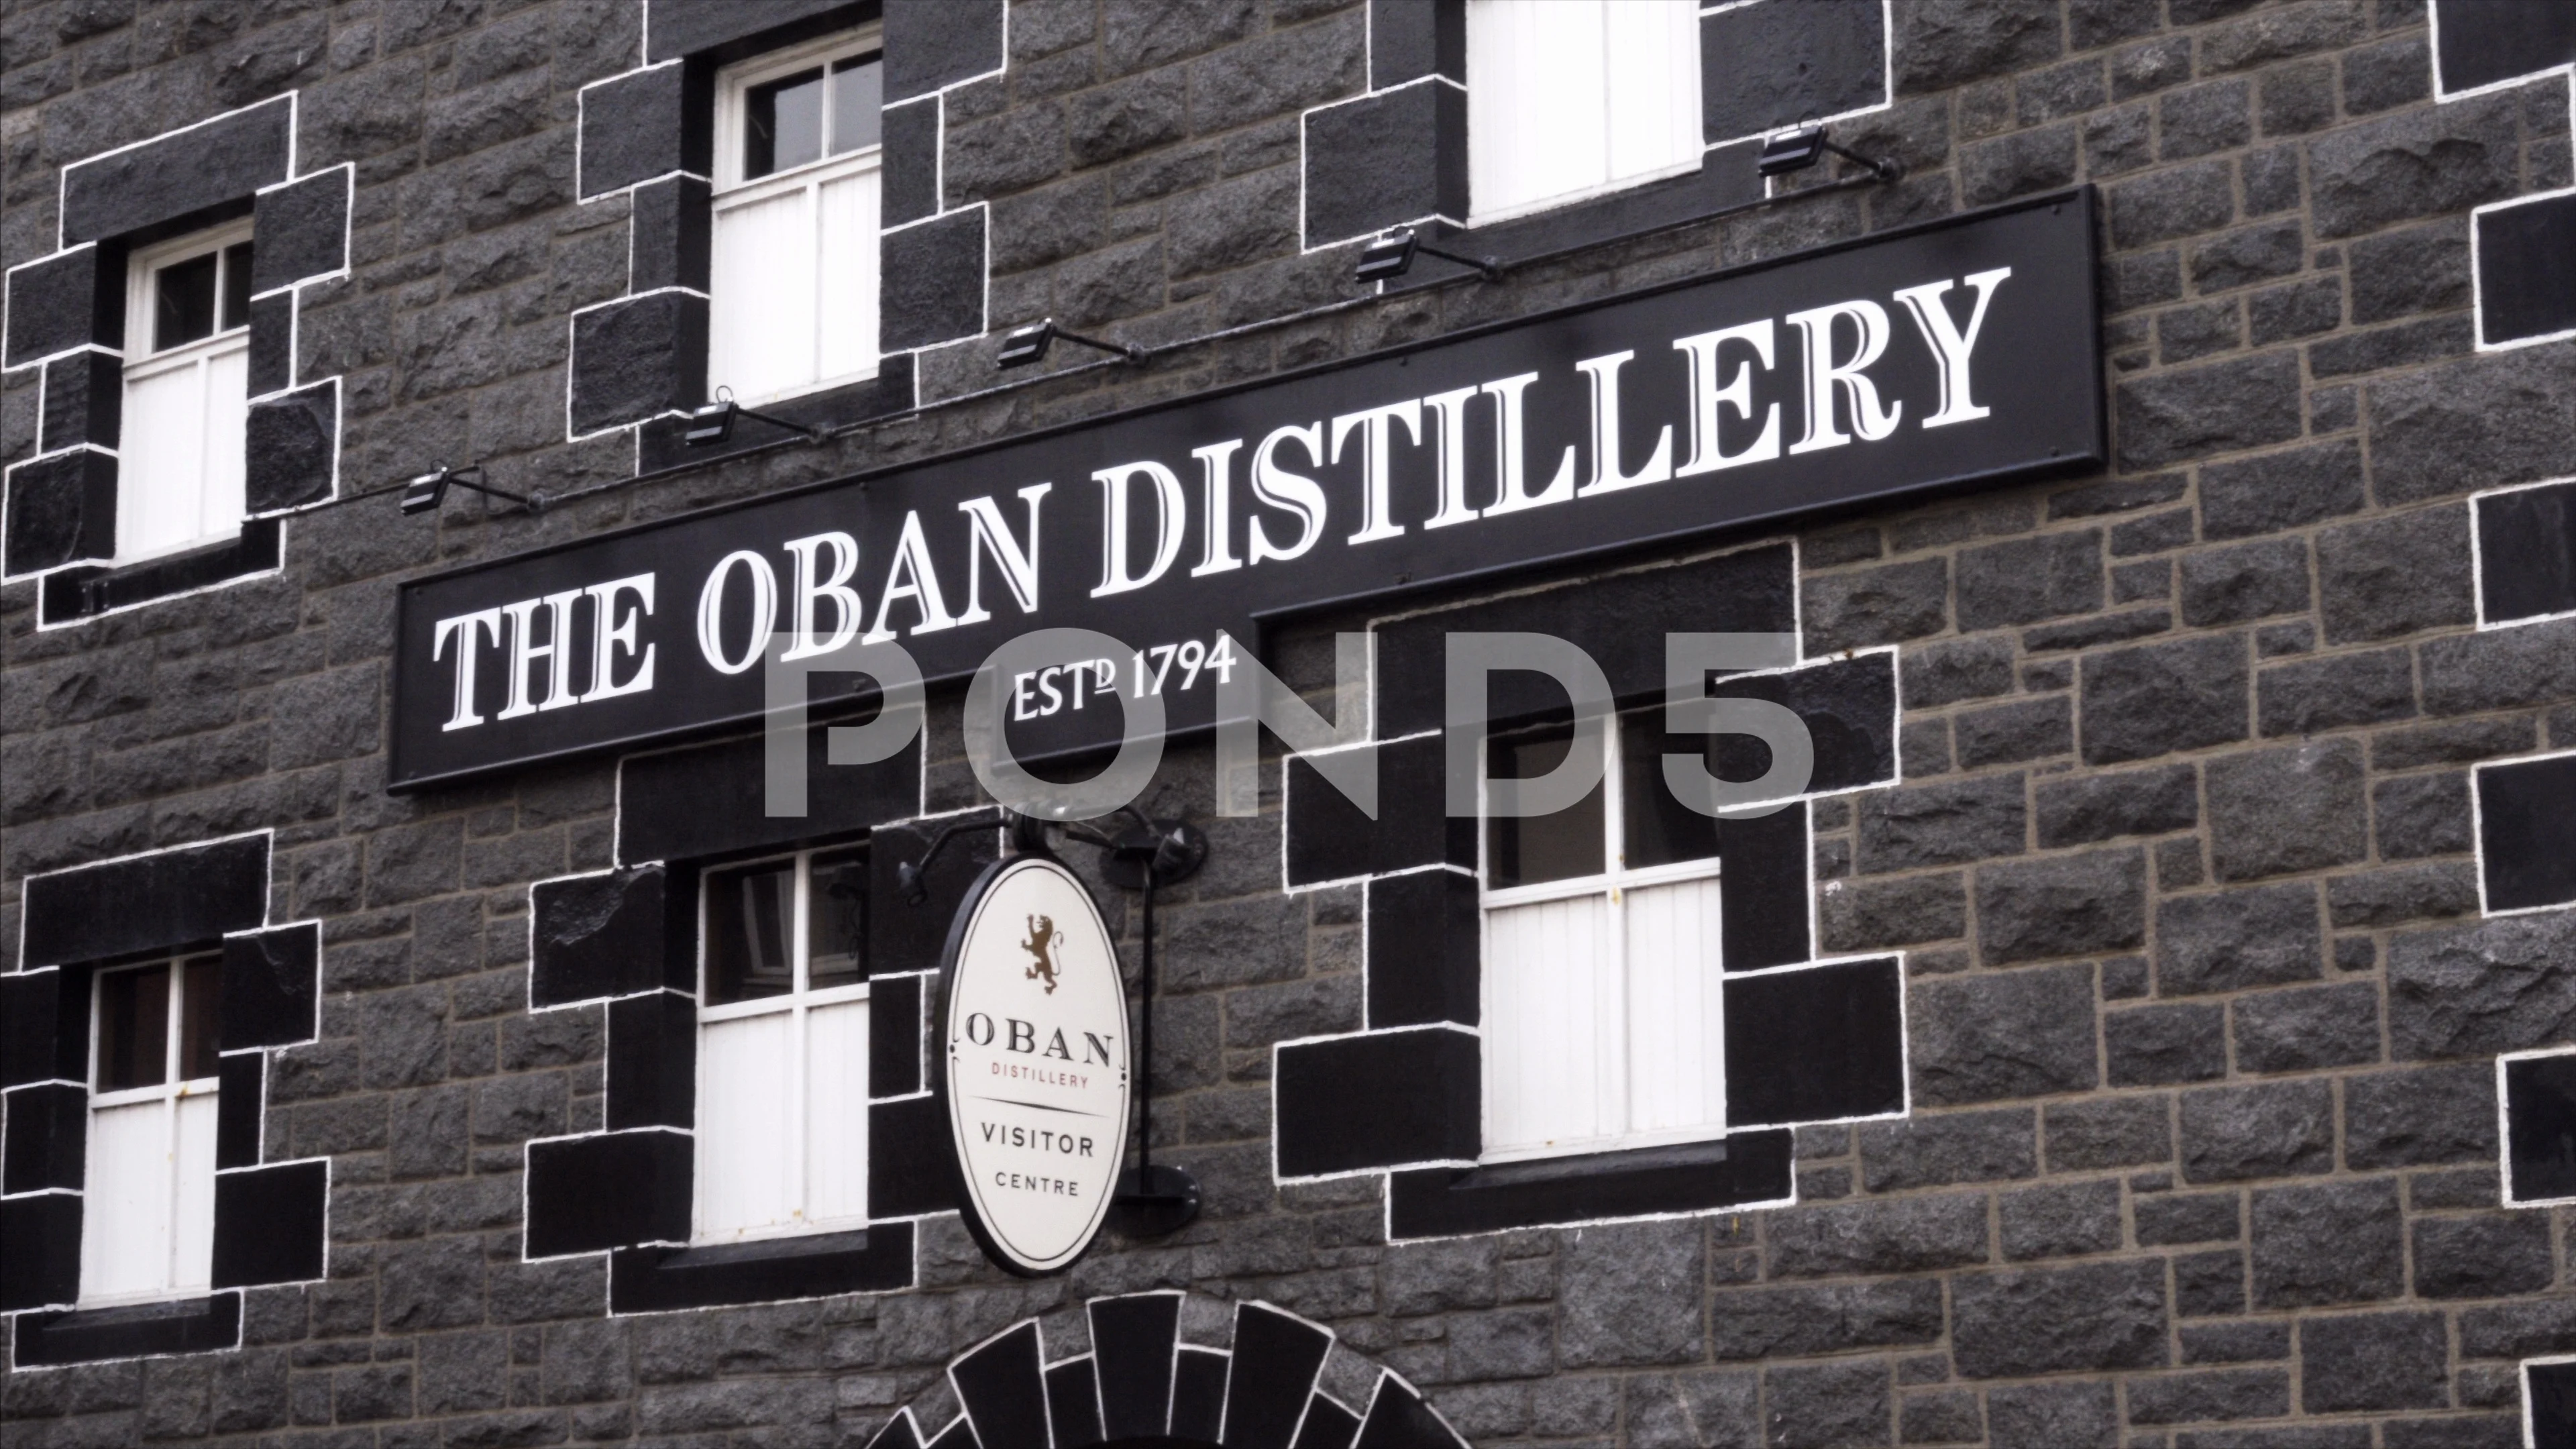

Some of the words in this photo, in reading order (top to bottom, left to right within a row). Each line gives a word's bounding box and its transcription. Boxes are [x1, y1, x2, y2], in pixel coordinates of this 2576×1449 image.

[433, 572, 655, 732] THE
[697, 483, 1052, 675] OBAN
[1090, 266, 2011, 598] DISTILLERY
[1132, 635, 1236, 698] 1794
[967, 1012, 1114, 1067] OBAN
[991, 1062, 1088, 1089] DISTILLERY
[981, 1122, 1093, 1157] VISITOR
[996, 1171, 1079, 1196] CENTRE
